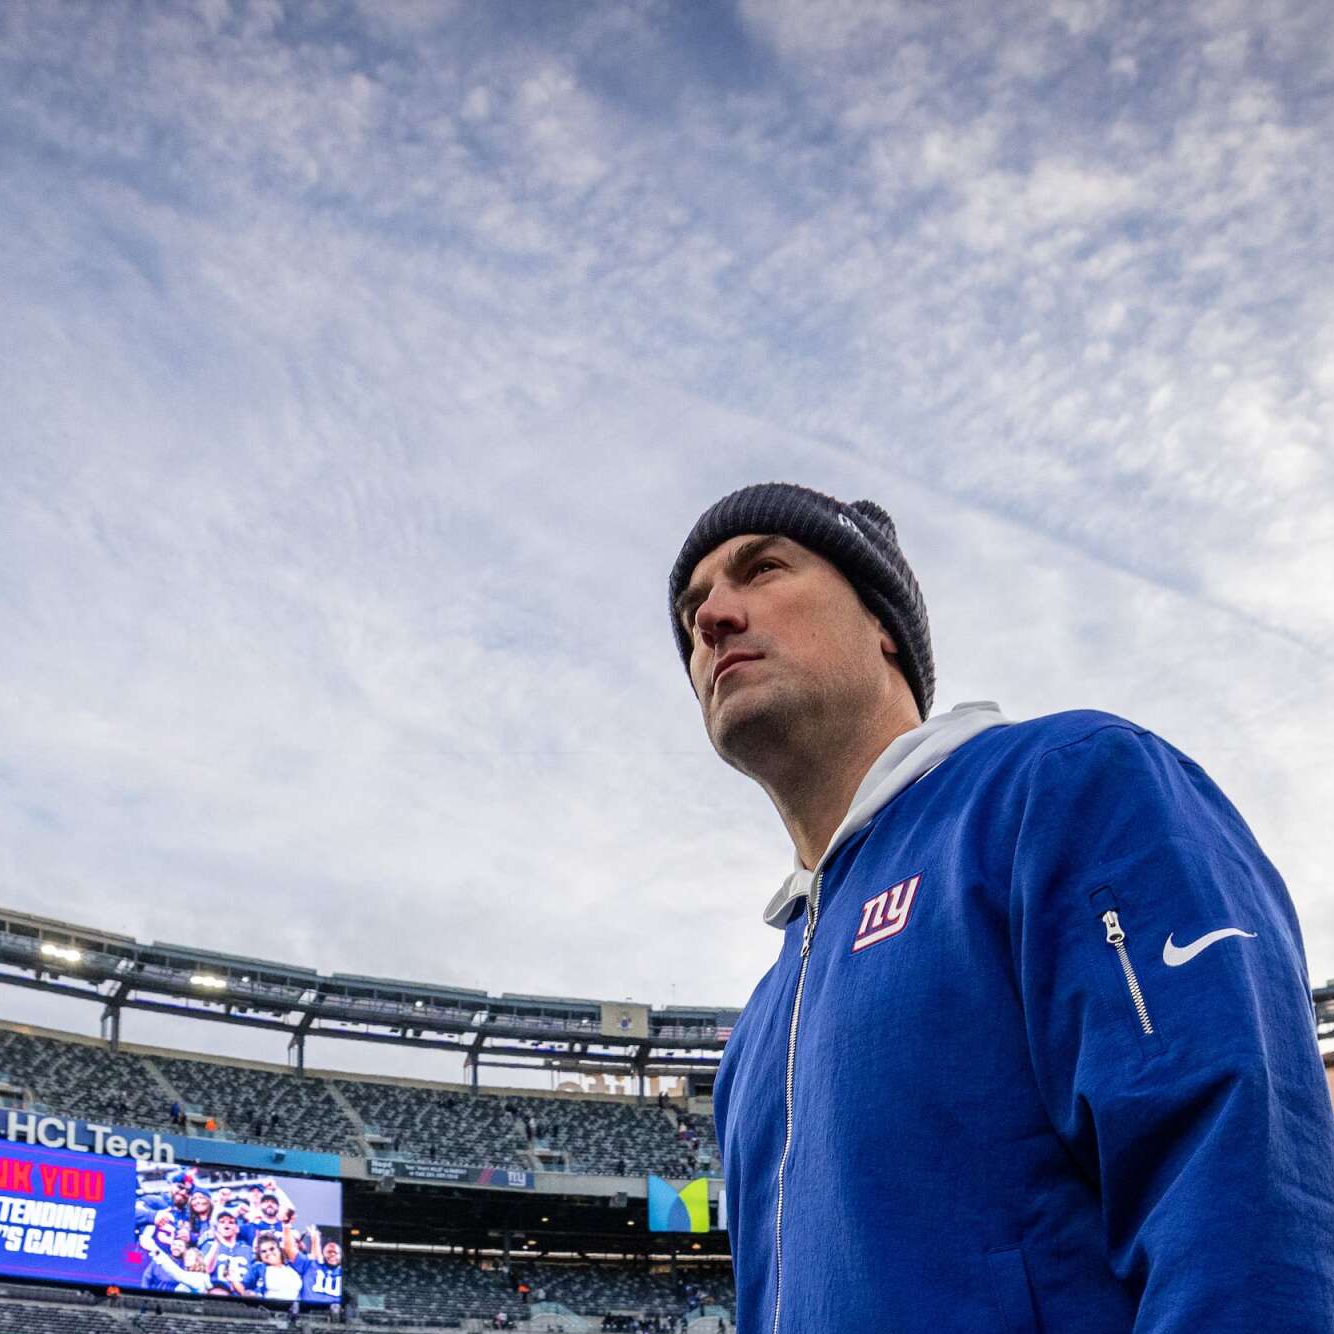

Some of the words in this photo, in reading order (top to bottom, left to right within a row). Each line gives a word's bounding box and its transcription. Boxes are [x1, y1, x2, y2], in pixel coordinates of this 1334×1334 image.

[853, 876, 920, 952] ny
[7, 1111, 174, 1164] HCLTech
[39, 1164, 105, 1203] YOU
[23, 1231, 90, 1260] GAME
